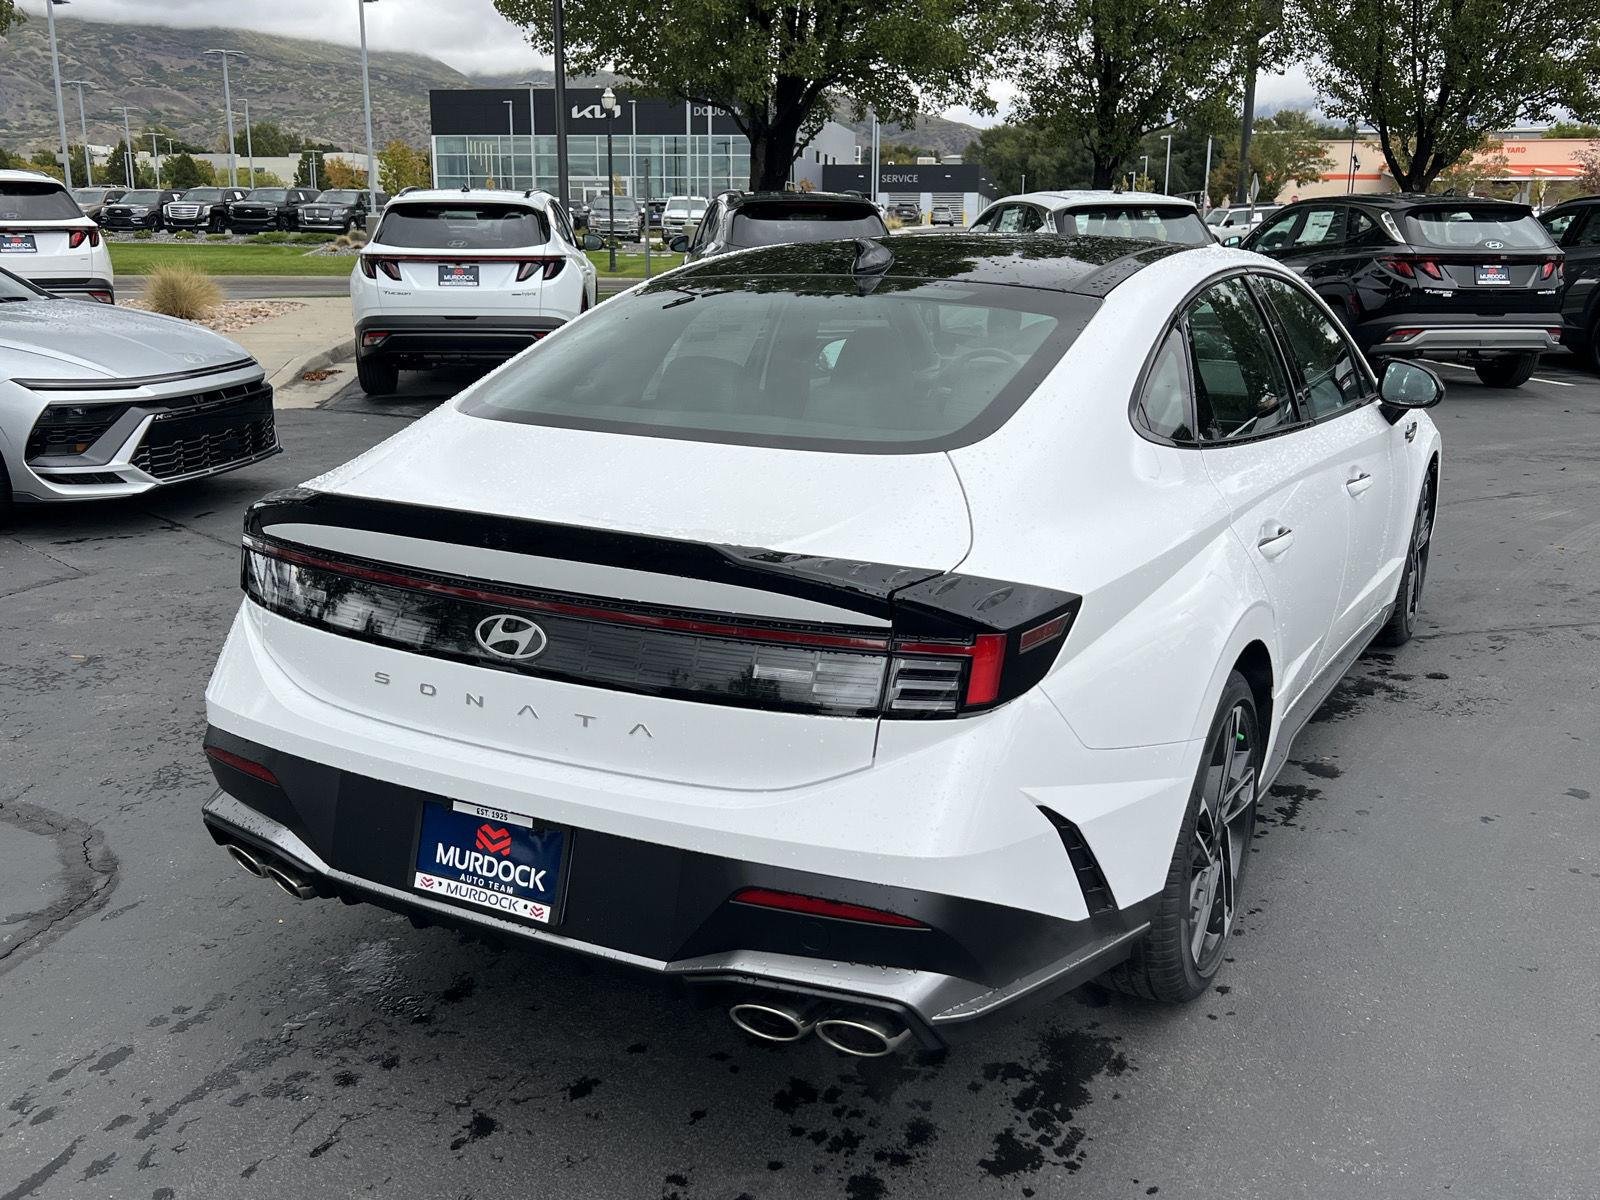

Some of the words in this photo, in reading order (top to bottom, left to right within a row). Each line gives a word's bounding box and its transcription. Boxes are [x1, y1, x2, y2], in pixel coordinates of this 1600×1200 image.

[1506, 146, 1527, 154] YARD
[881, 174, 919, 183] SERVICE
[373, 670, 655, 738] SONATA
[476, 807, 490, 817] EST.
[491, 810, 508, 821] 1925
[435, 842, 547, 892] MURDOCK
[459, 873, 485, 887] AUTO
[489, 880, 514, 895] TEAM
[445, 882, 520, 912] MURDOCK
